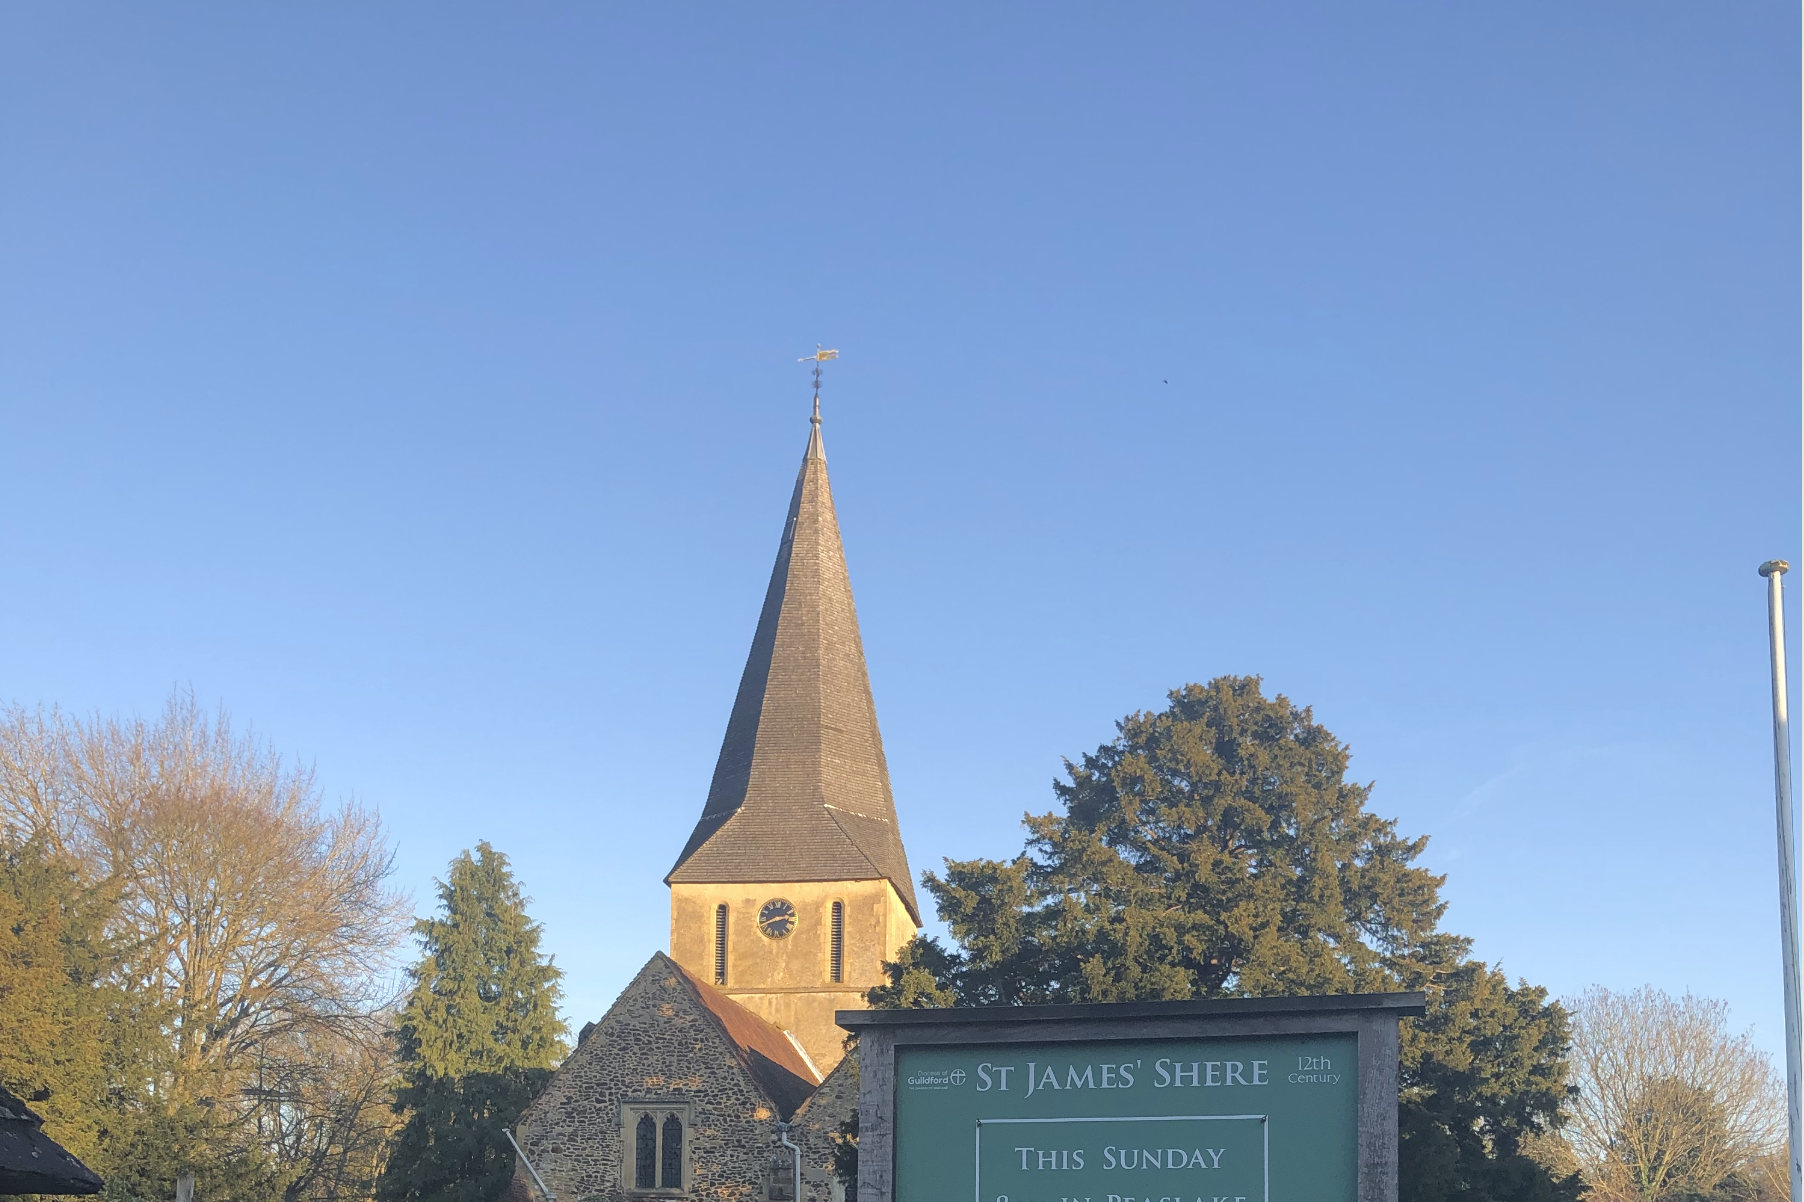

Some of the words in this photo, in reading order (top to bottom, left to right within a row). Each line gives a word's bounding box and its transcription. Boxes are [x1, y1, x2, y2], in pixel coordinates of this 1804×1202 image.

[1297, 1055, 1331, 1071] 12th
[907, 1075, 949, 1085] Guildford
[976, 1062, 1015, 1092] ST
[1153, 1058, 1270, 1089] SHERE
[1287, 1072, 1341, 1085] Century
[1014, 1147, 1085, 1171] THIS
[1102, 1145, 1227, 1170] SUNDAY
